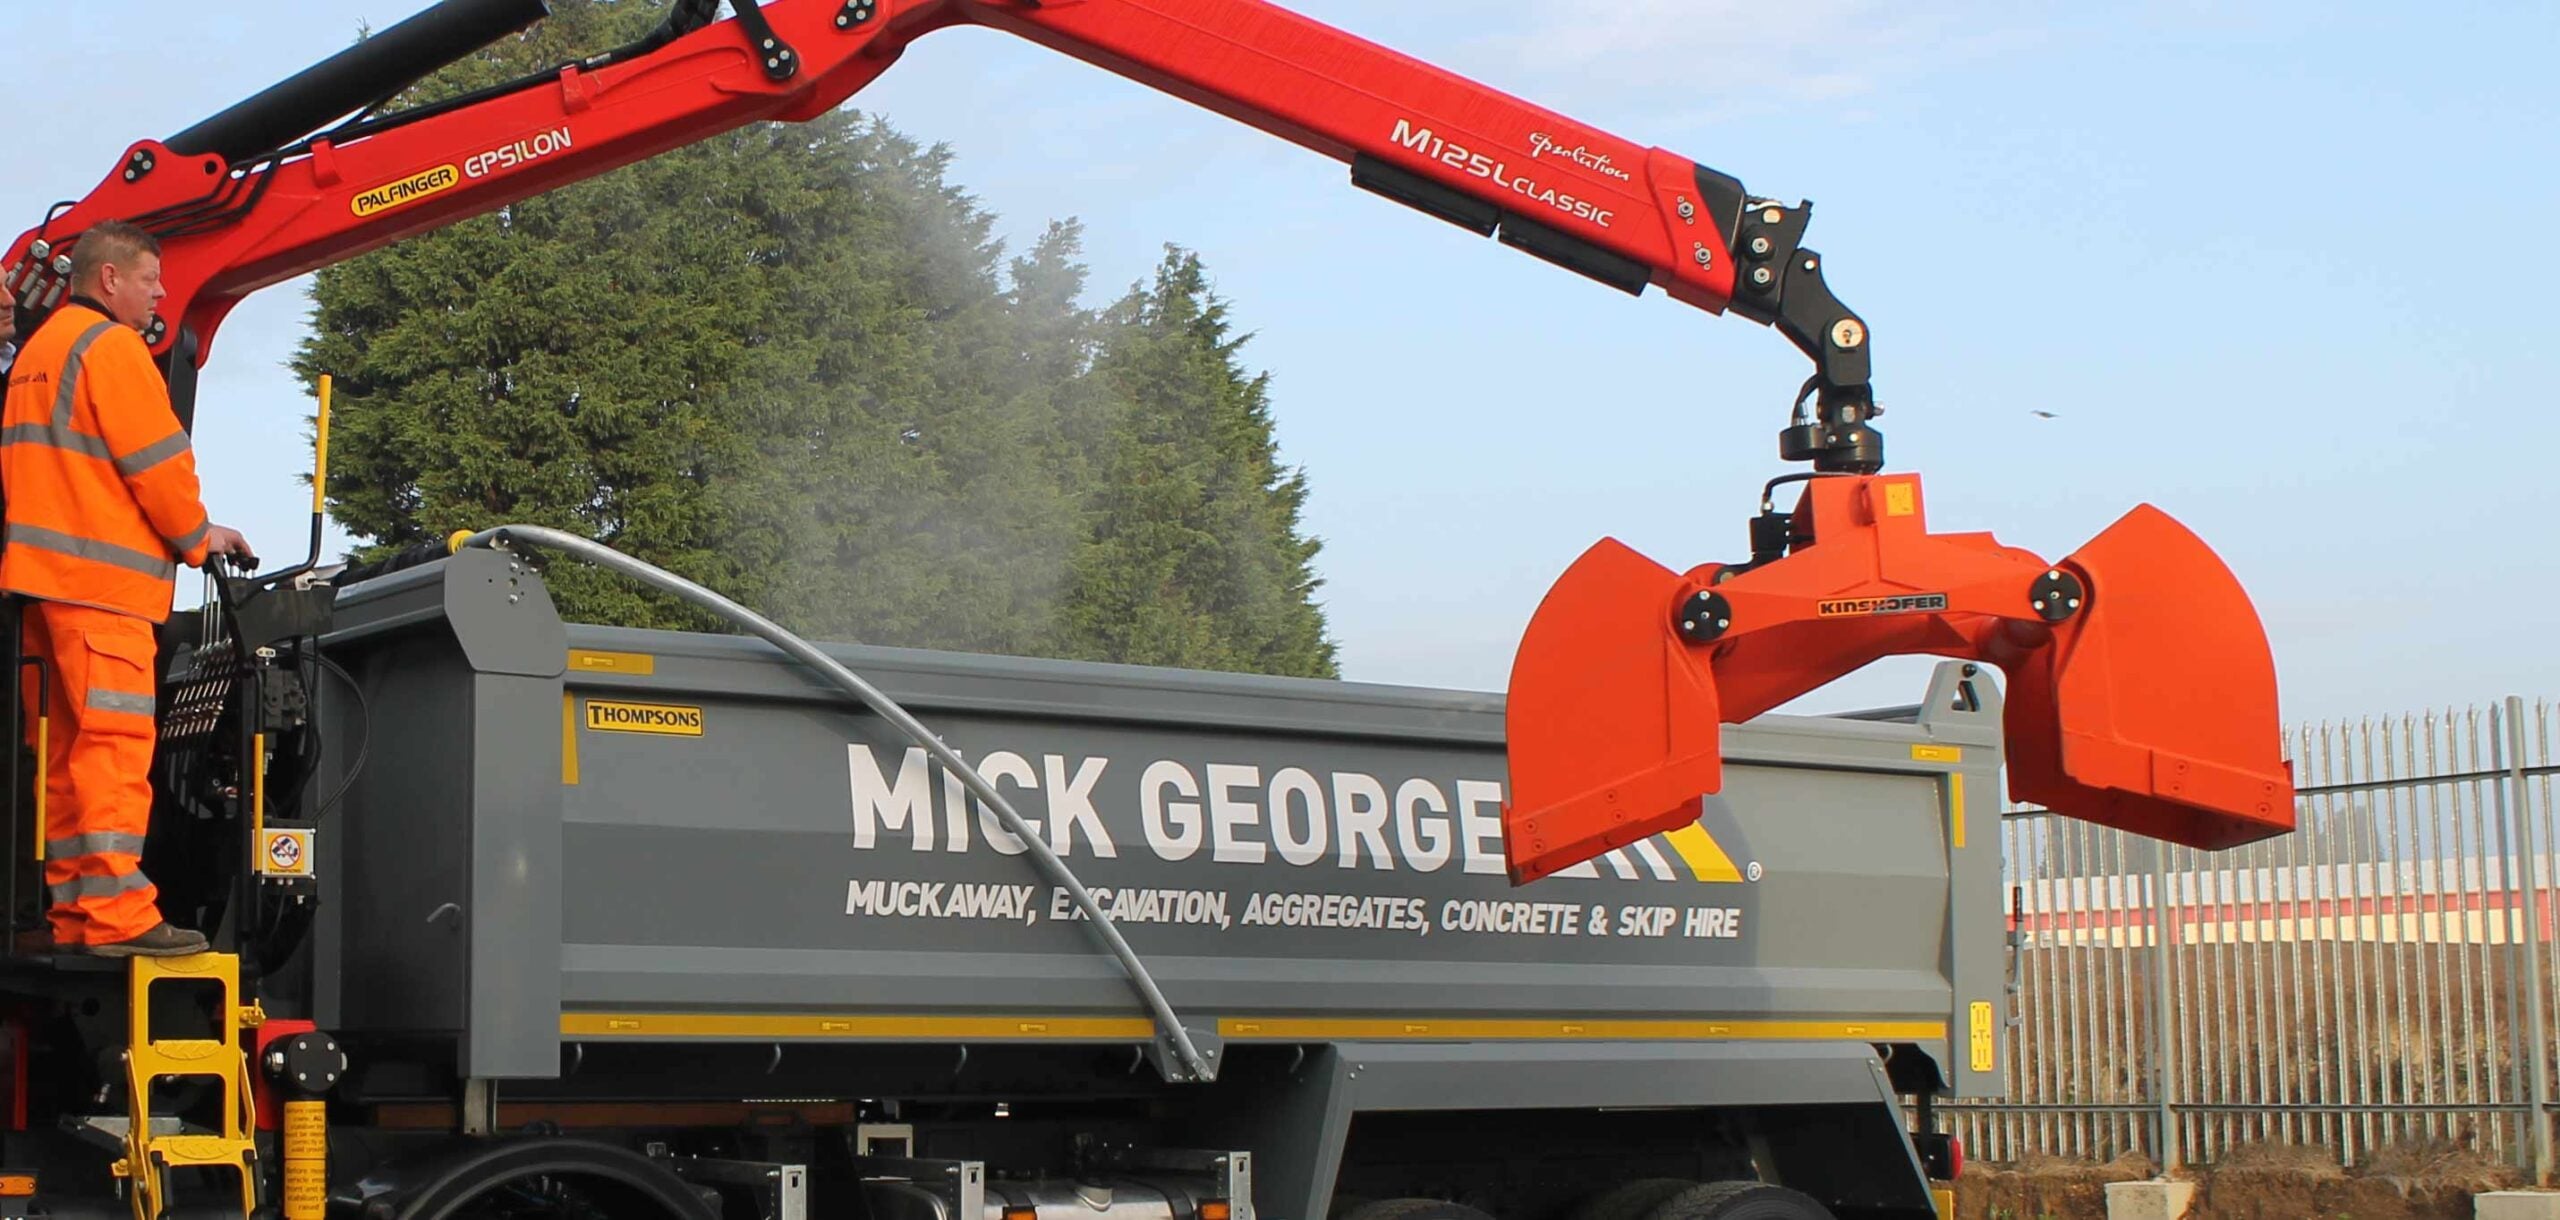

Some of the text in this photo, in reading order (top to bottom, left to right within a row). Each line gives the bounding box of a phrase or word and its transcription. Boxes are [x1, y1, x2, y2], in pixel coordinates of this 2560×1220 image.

[357, 126, 573, 213] PALFINGER EPSILON
[1512, 177, 1614, 228] CLASSIC
[589, 705, 700, 727] THOMPSONS
[847, 743, 1508, 875] MICK GEORGE
[845, 879, 1037, 926] MUCKAWAY,
[1241, 892, 1430, 936] AGGREGATES,
[1441, 899, 1581, 935] CONCRETE
[1588, 904, 1608, 936] &
[1617, 906, 1676, 937] SKIP
[1684, 907, 1741, 938] HIRE
